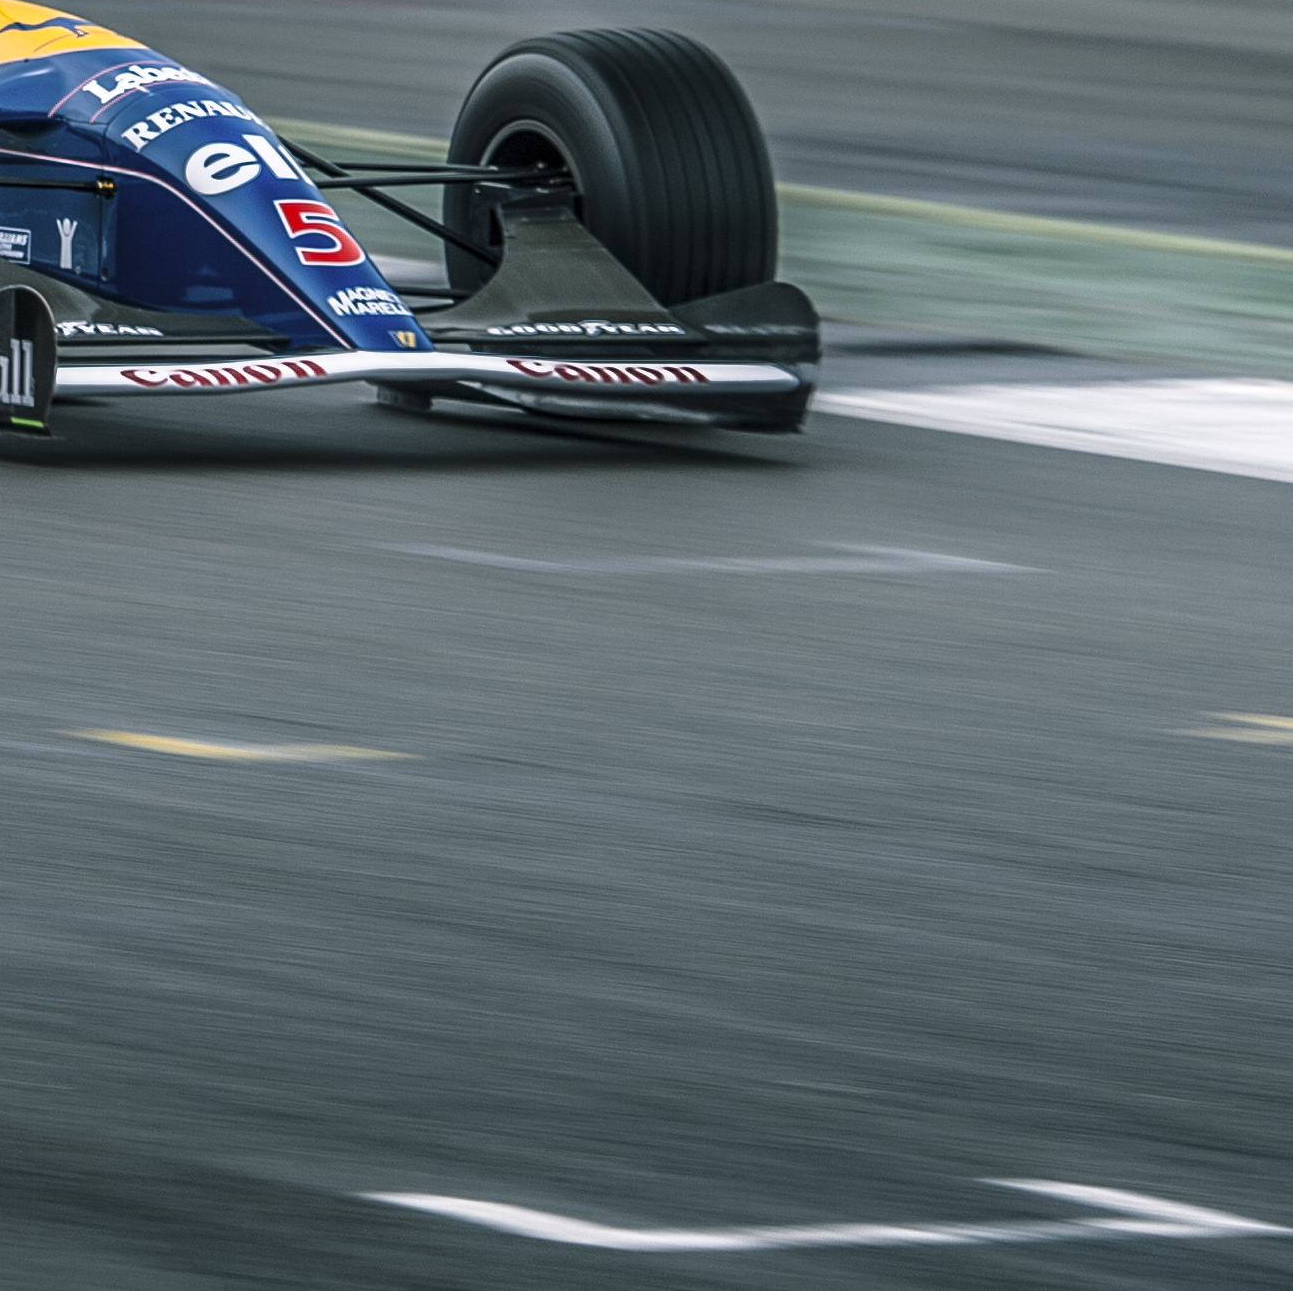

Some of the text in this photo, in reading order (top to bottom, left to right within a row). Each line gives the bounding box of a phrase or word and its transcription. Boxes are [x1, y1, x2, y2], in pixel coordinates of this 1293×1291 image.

[120, 100, 272, 153] RENAU
[273, 198, 365, 266] 5
[120, 359, 328, 387] Canon
[506, 359, 711, 385] Canon
